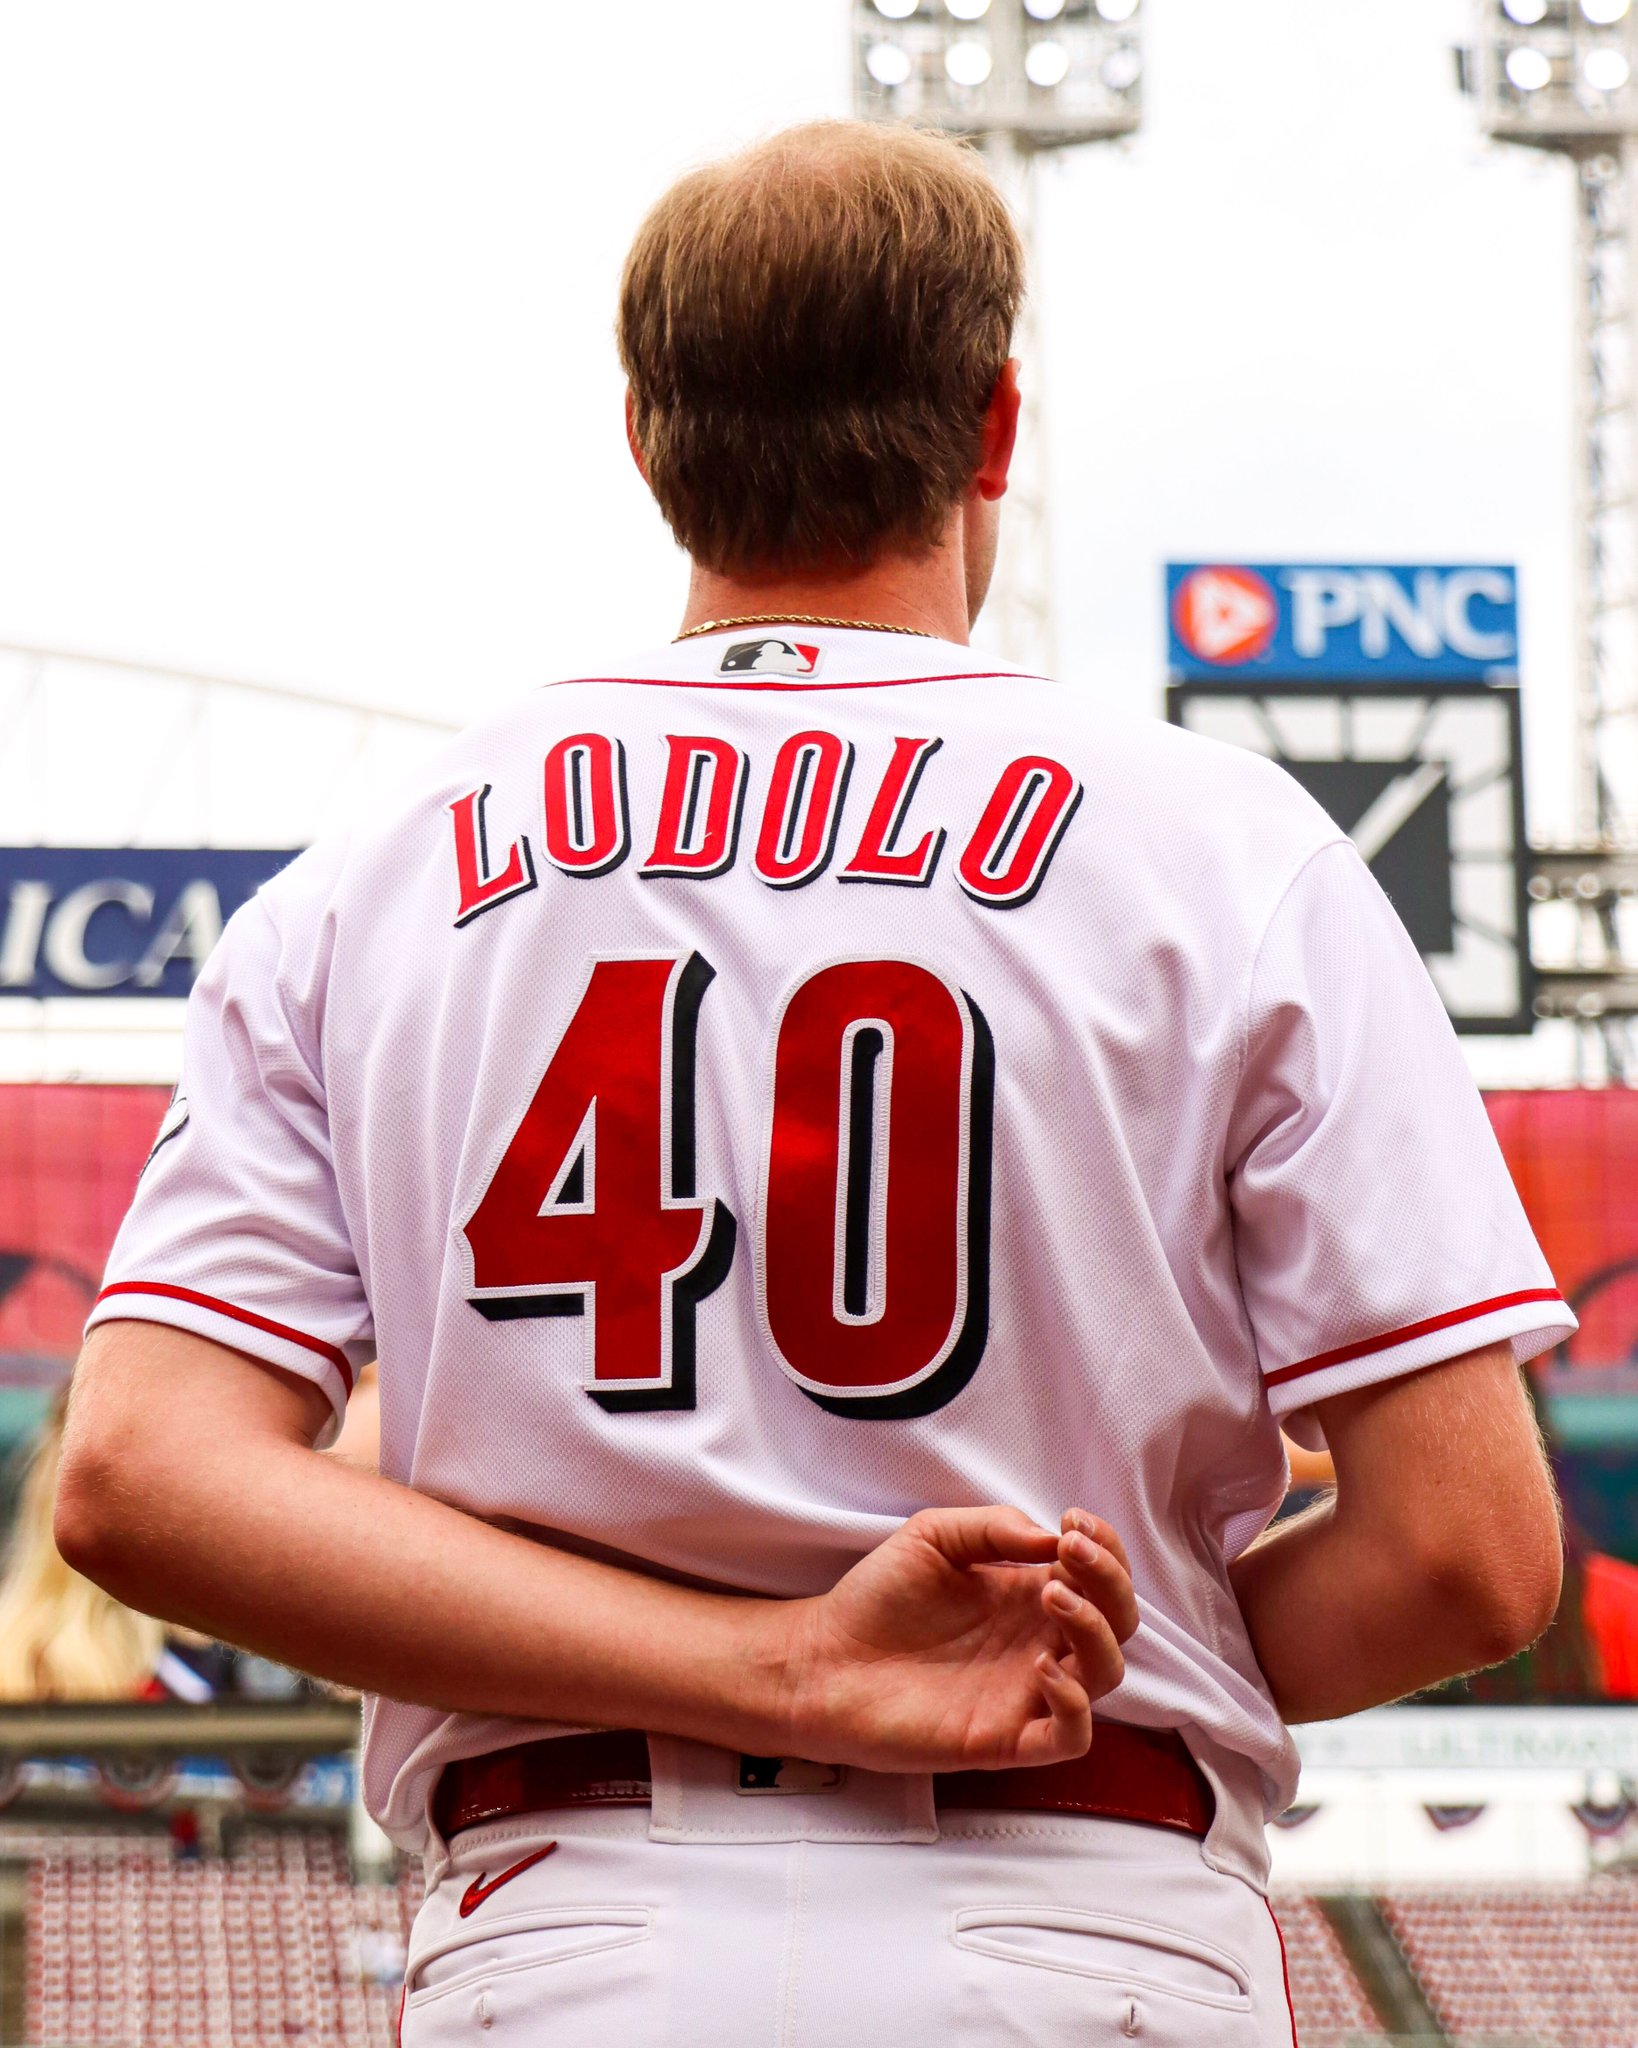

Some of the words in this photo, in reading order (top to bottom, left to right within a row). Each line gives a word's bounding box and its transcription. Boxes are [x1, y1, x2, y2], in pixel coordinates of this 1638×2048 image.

[1279, 567, 1515, 660] PNC
[446, 730, 1083, 927] LODOLO
[451, 949, 995, 1420] 40
